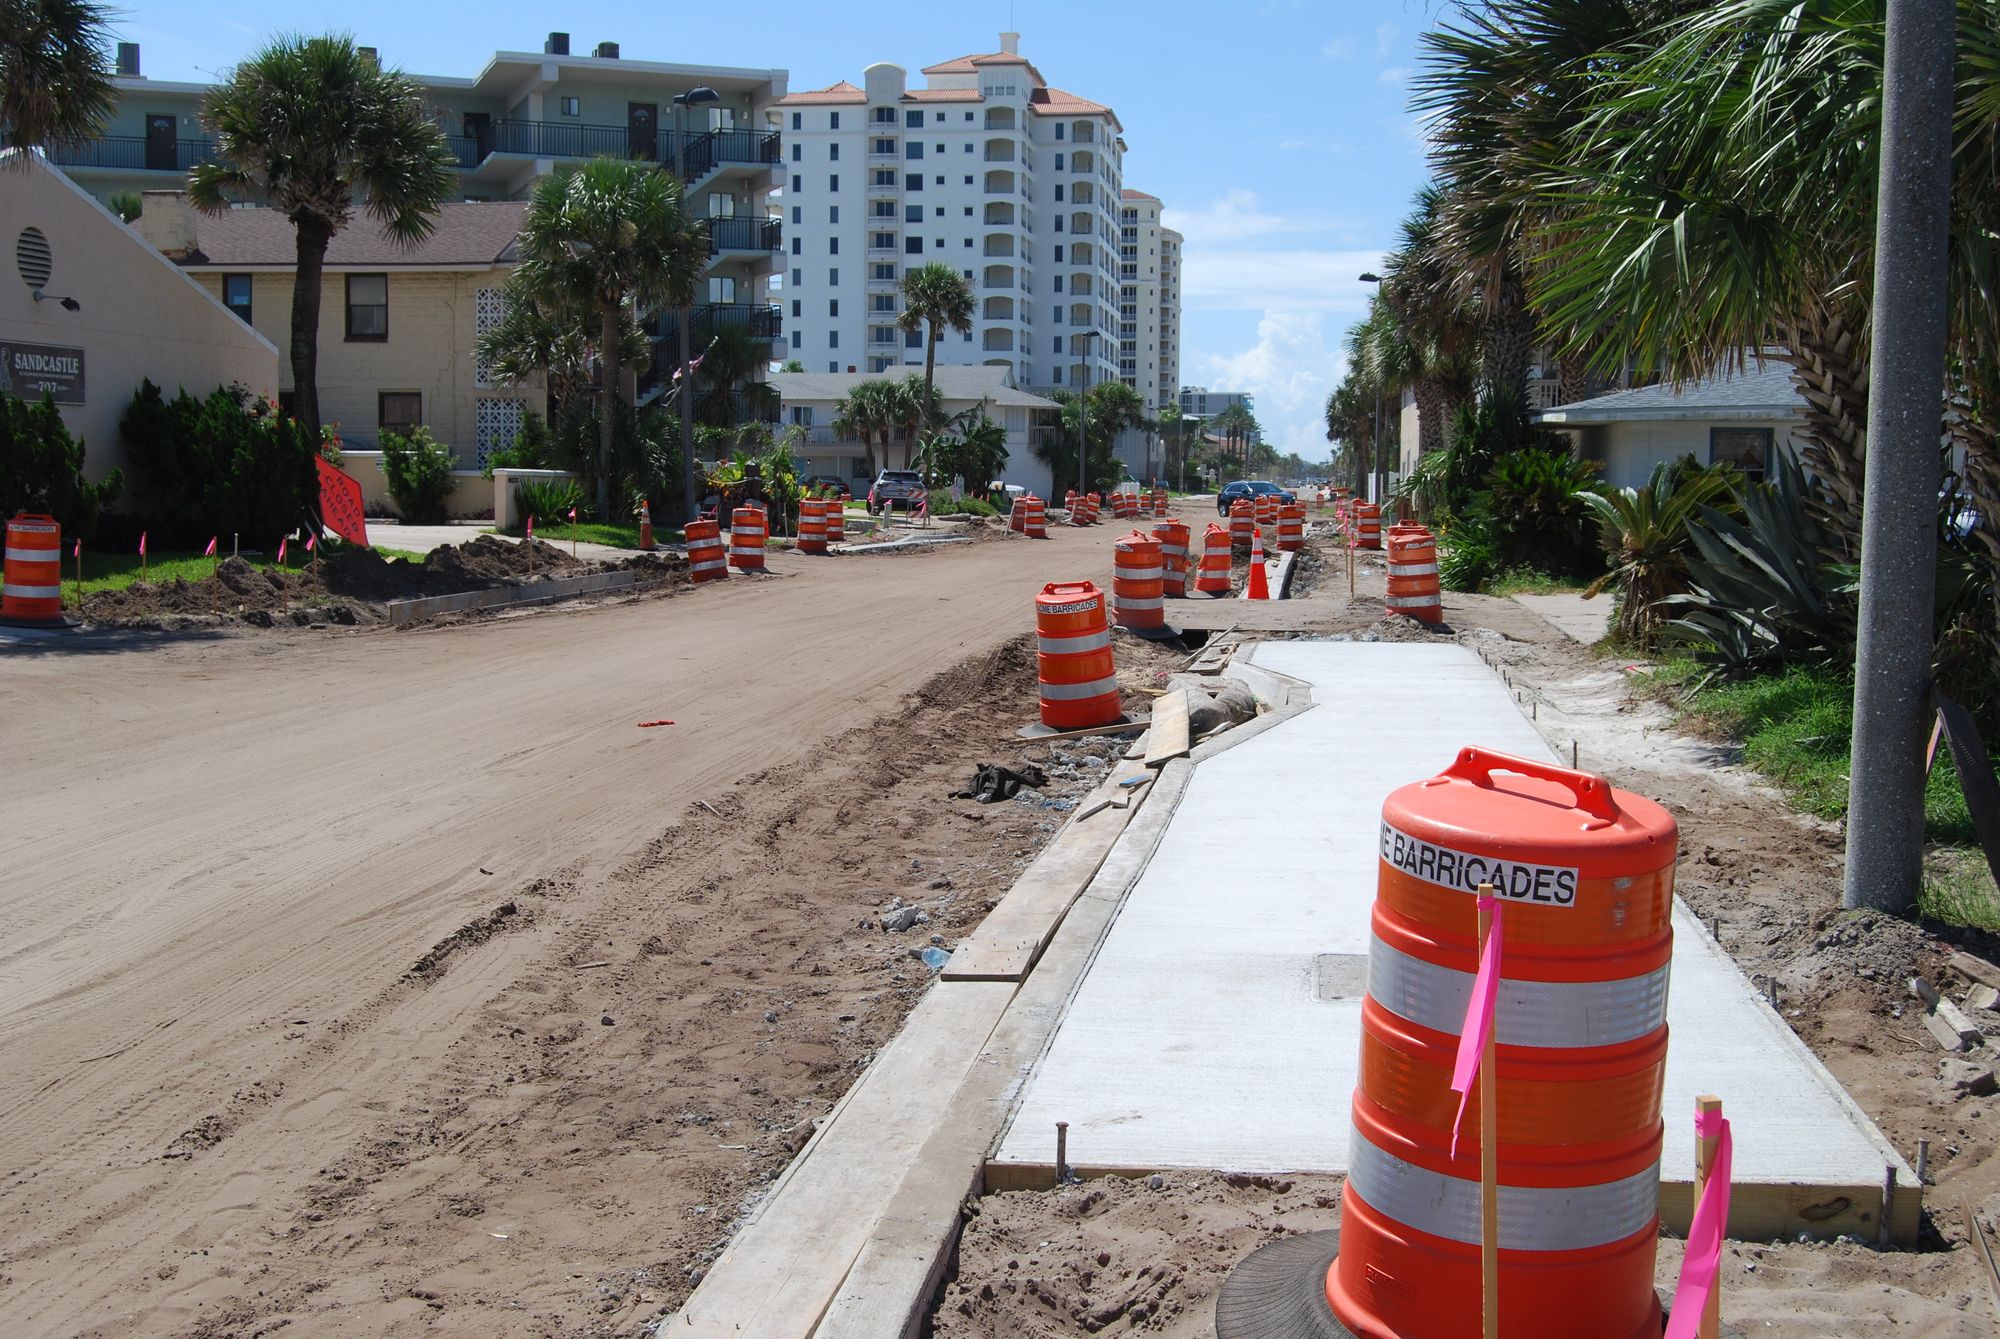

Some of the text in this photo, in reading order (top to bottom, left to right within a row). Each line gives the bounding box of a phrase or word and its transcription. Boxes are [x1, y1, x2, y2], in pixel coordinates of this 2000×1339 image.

[15, 353, 79, 374] SANDCASTLE
[38, 381, 57, 392] 707
[320, 488, 350, 536] AHEAD
[326, 476, 358, 532] CLOSED
[337, 477, 360, 517] ROAD
[1052, 600, 1097, 614] BARRICADES
[1393, 834, 1576, 904] BARRICADES
